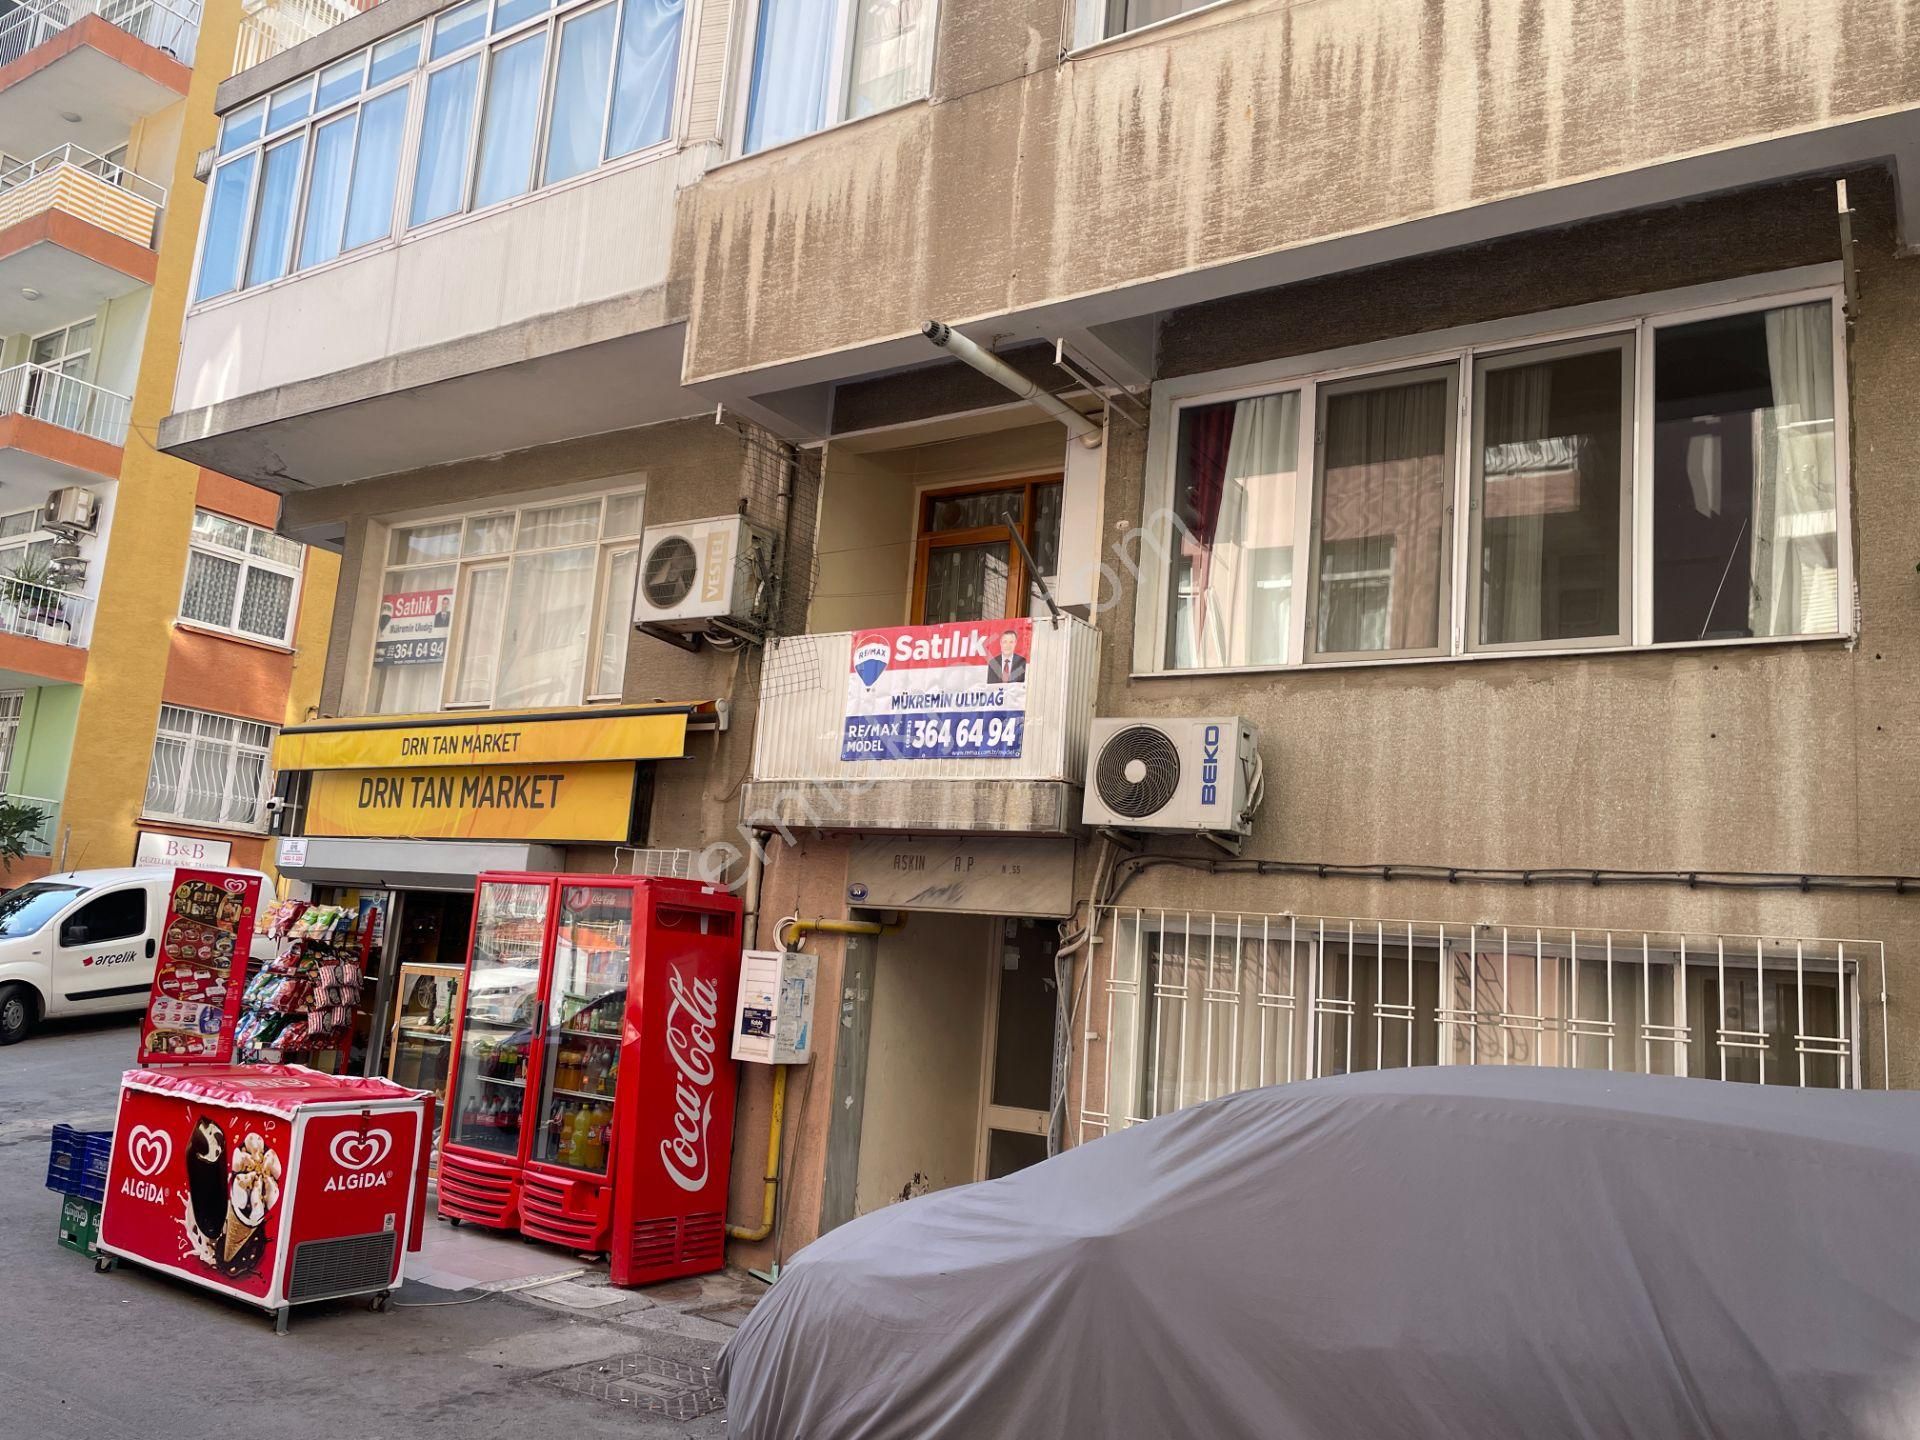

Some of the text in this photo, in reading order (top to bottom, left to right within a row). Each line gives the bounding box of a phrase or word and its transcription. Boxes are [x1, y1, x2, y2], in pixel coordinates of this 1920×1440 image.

[706, 534, 725, 599] VESTEL
[395, 596, 433, 617] Satılık
[394, 643, 413, 659] 364
[415, 642, 428, 657] 64
[430, 641, 444, 657] 94
[858, 648, 886, 660] RE/MAX
[894, 629, 988, 662] Satılık
[891, 687, 1004, 711] MÜKREMİN ULUDAĞ
[848, 723, 899, 738] RE/MAX
[911, 718, 951, 749] 364
[956, 718, 984, 748] 64
[987, 717, 1017, 747] 94
[401, 732, 521, 756] DRN TAN MARKET
[846, 739, 884, 753] MODEL
[1201, 725, 1220, 805] BEKO
[358, 774, 565, 809] DRN TAN MARKET
[166, 840, 205, 860] B&B
[95, 950, 138, 967] arçelik
[660, 962, 718, 1192] Coca-Cola
